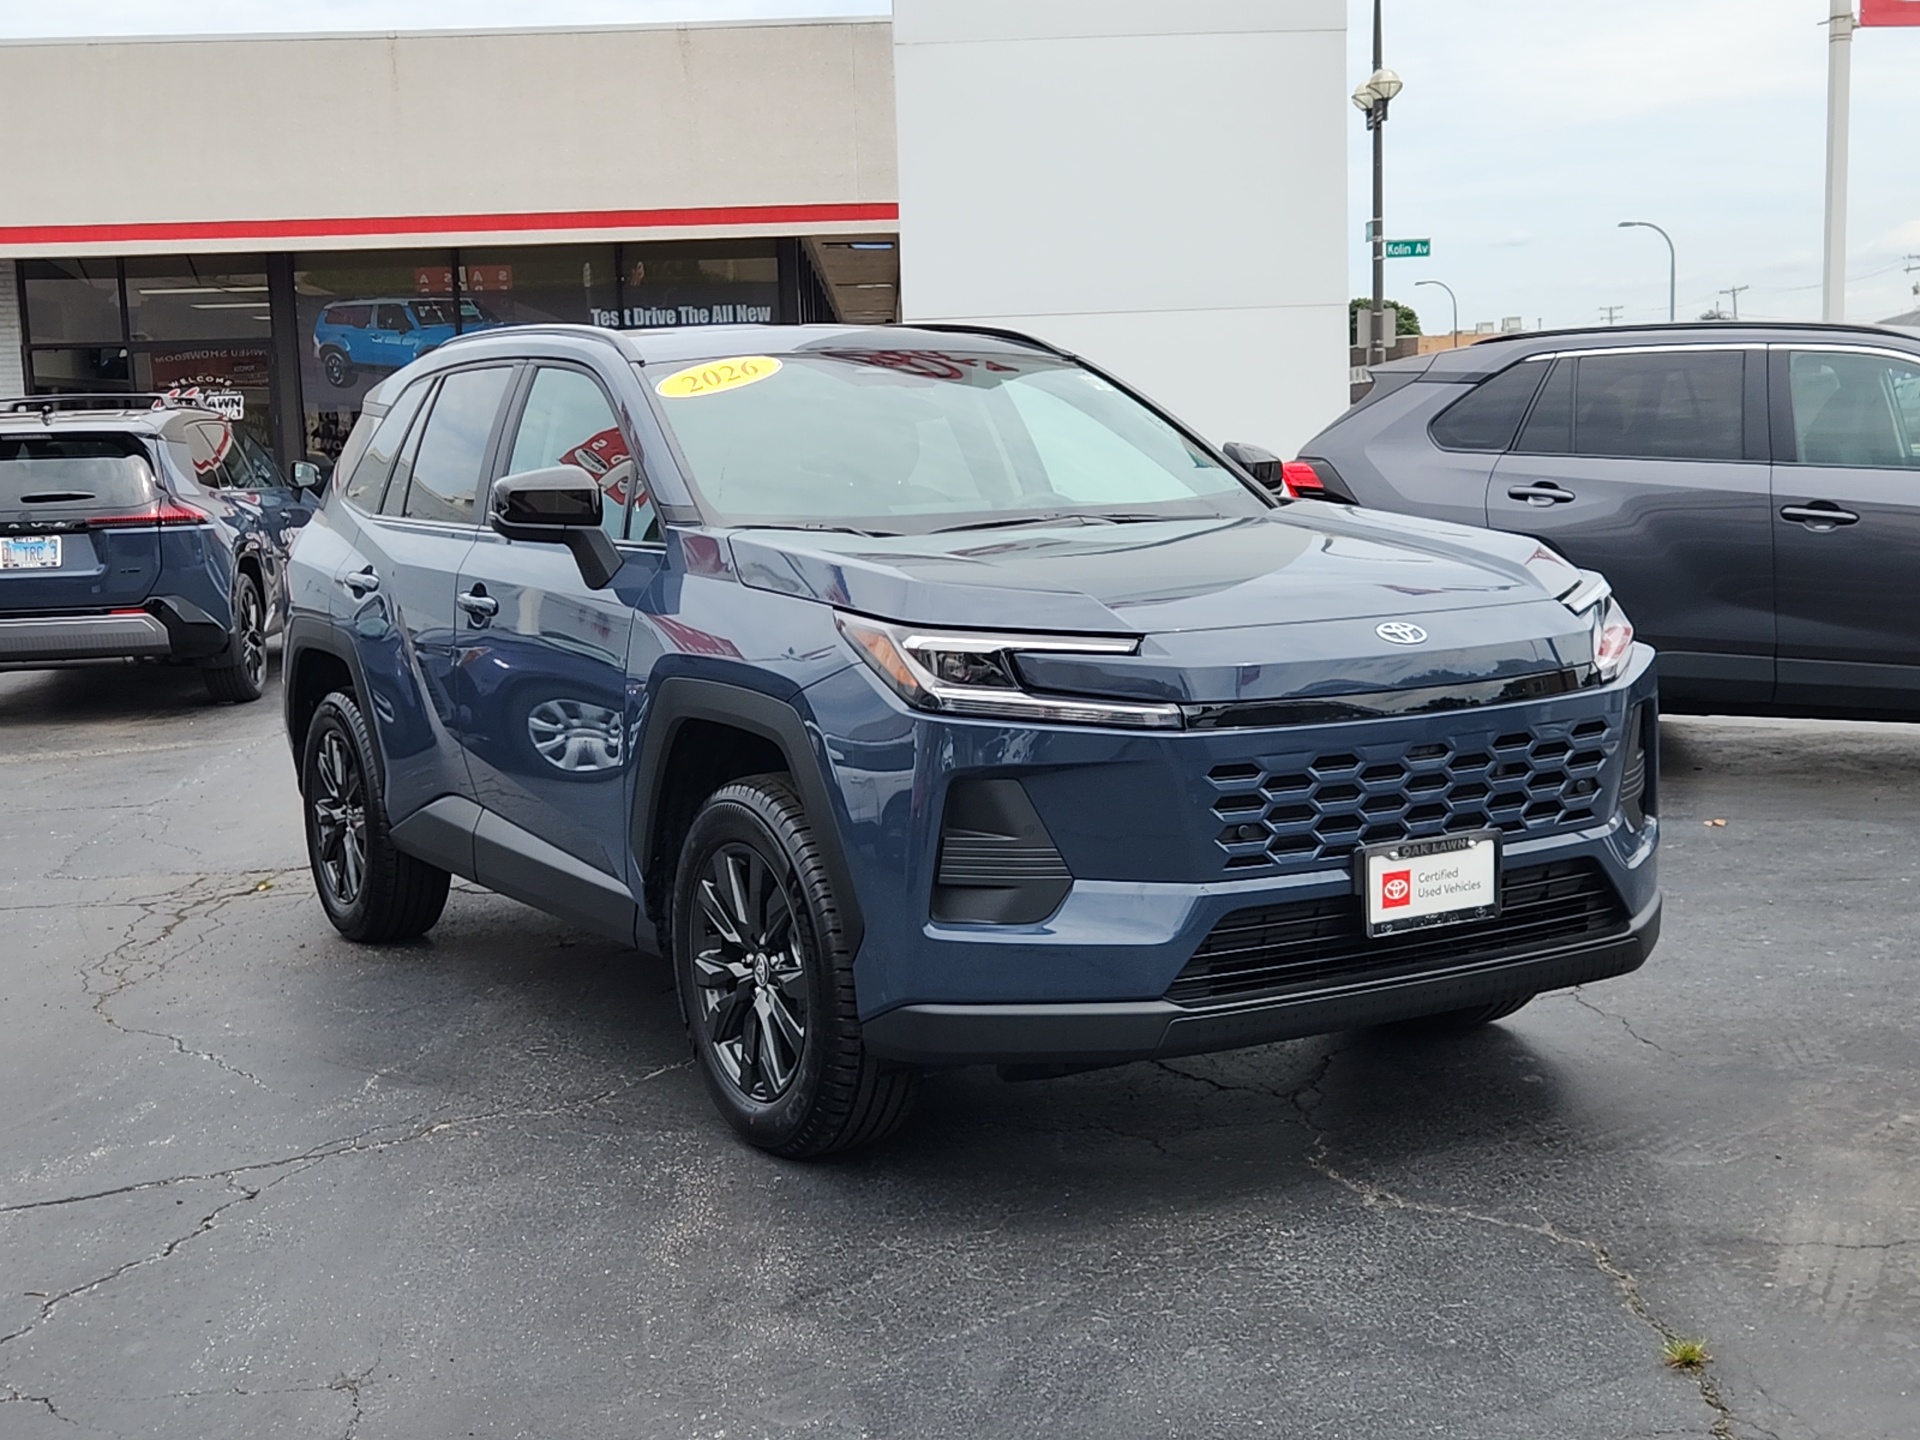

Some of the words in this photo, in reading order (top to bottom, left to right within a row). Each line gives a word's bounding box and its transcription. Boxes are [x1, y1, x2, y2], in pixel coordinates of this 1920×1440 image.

[1387, 243, 1411, 255] Kolin
[1415, 243, 1429, 254] Av
[633, 307, 676, 326] Drive
[678, 305, 709, 324] The
[712, 304, 734, 323] All
[737, 303, 771, 322] New
[168, 376, 233, 388] WELCOME
[681, 361, 759, 393] 2026
[1432, 838, 1467, 853] LAWN
[1417, 867, 1459, 883] Certified
[1417, 885, 1442, 898] Used
[1443, 881, 1481, 894] Vehicles
